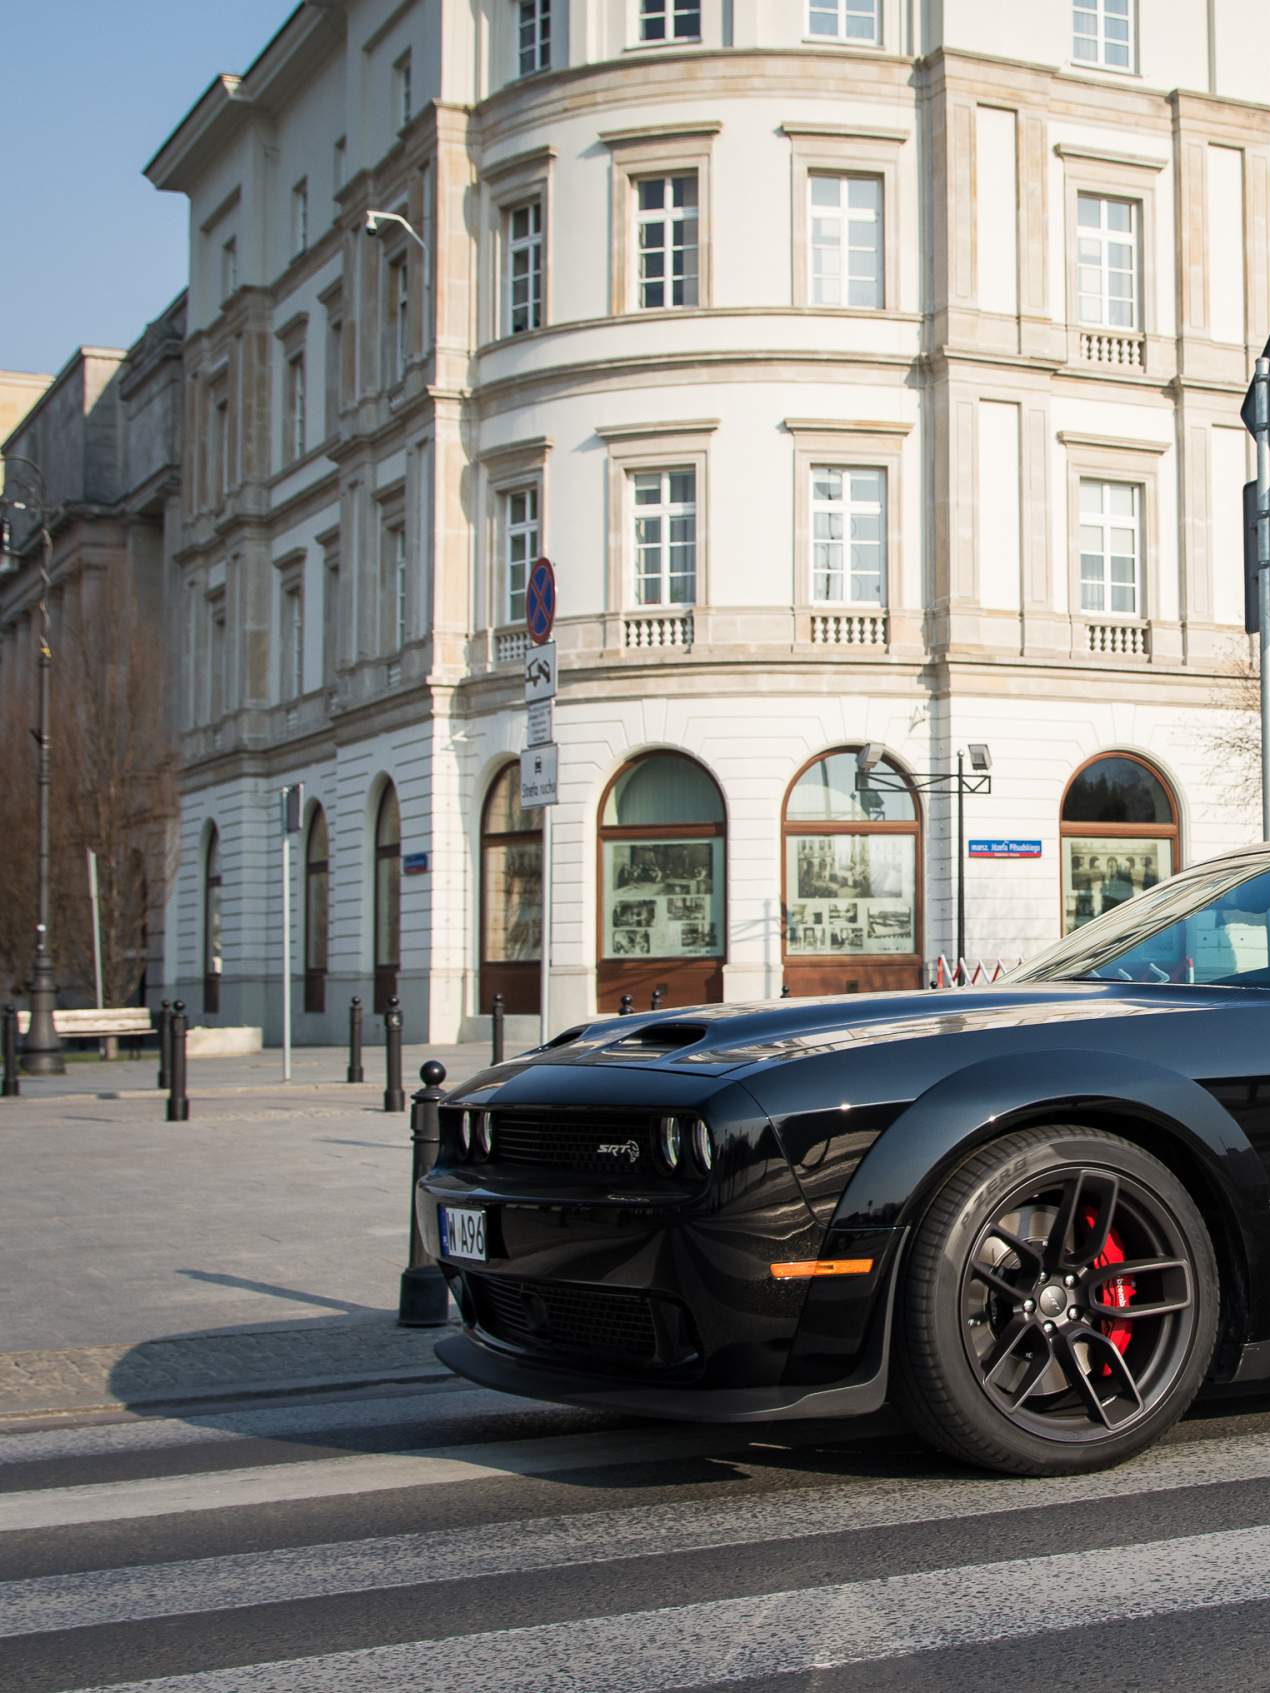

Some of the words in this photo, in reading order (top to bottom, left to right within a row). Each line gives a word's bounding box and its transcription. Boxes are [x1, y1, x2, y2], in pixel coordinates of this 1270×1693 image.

[597, 1144, 630, 1156] SRT
[446, 1212, 456, 1251] W
[461, 1214, 484, 1255] A96
[1116, 1278, 1127, 1308] bremb
